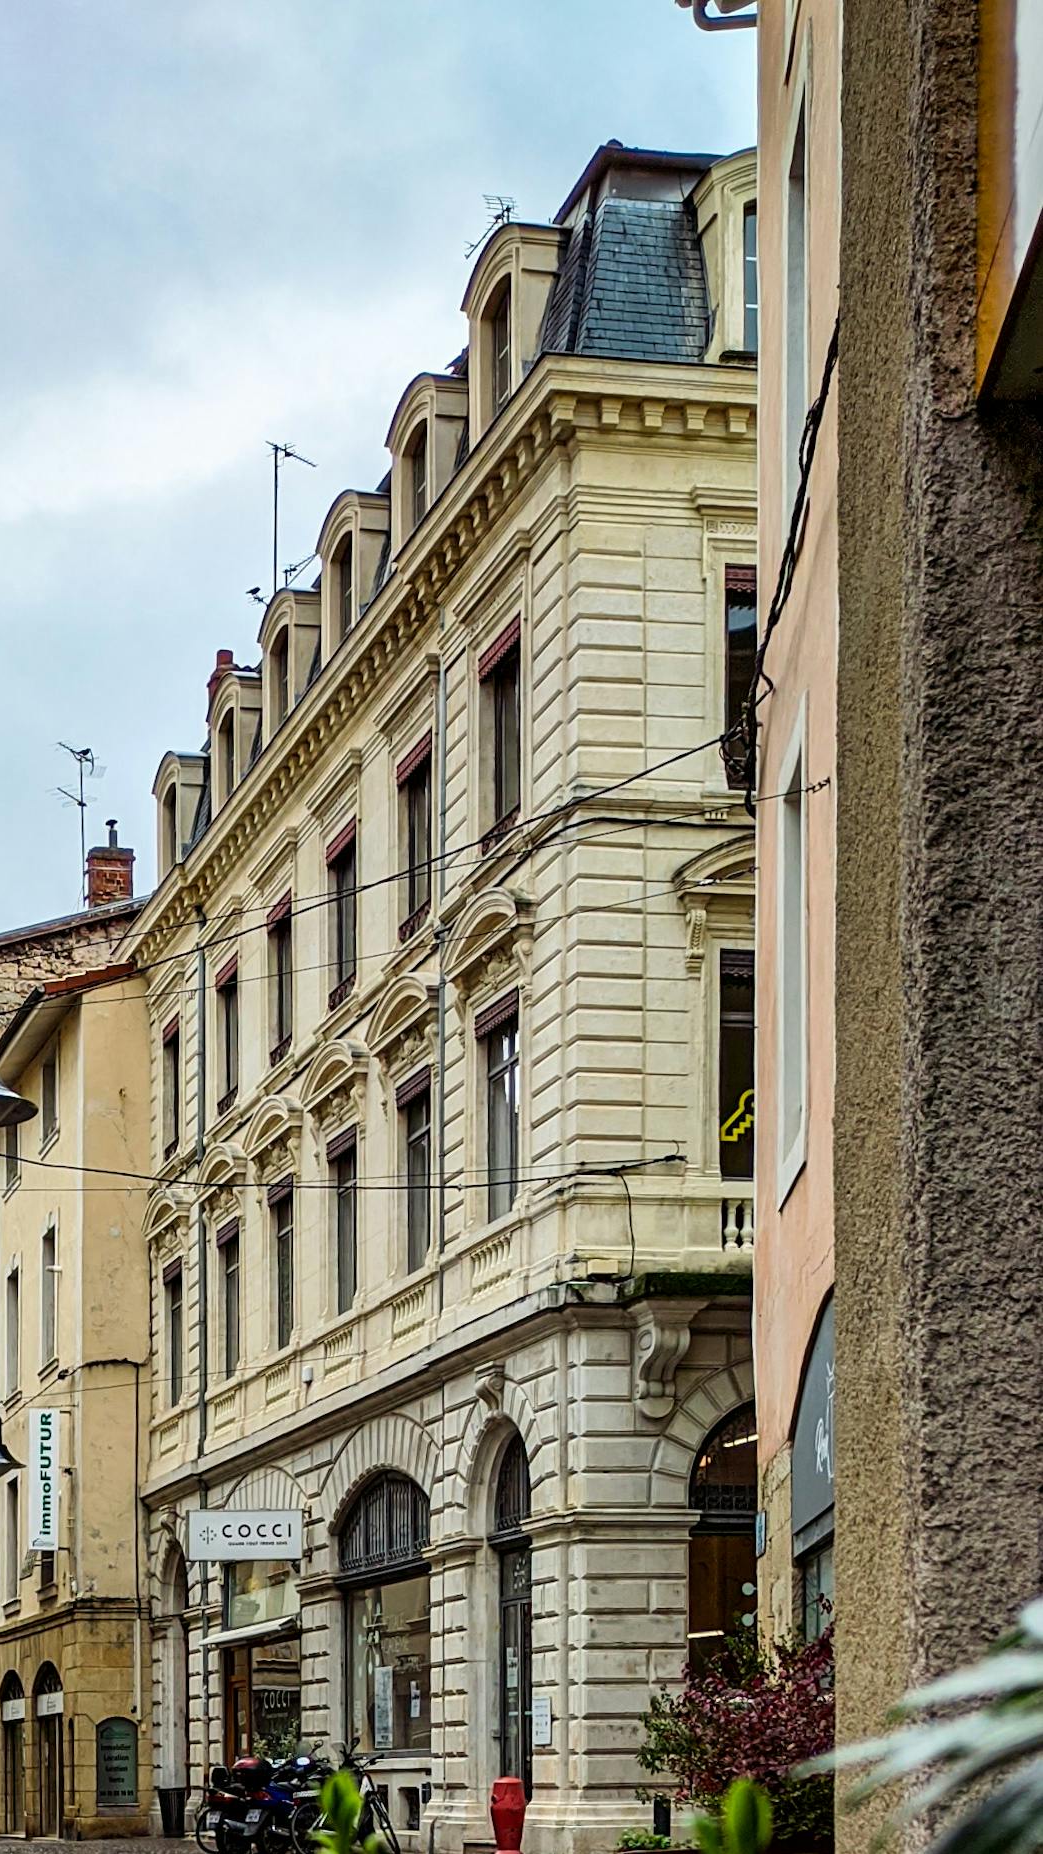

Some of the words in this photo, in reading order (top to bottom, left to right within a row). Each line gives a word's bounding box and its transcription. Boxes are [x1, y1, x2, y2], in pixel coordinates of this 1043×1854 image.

[39, 1412, 52, 1535] immoFUTUR
[222, 1523, 291, 1538] COCCI
[264, 1690, 290, 1709] COCCI
